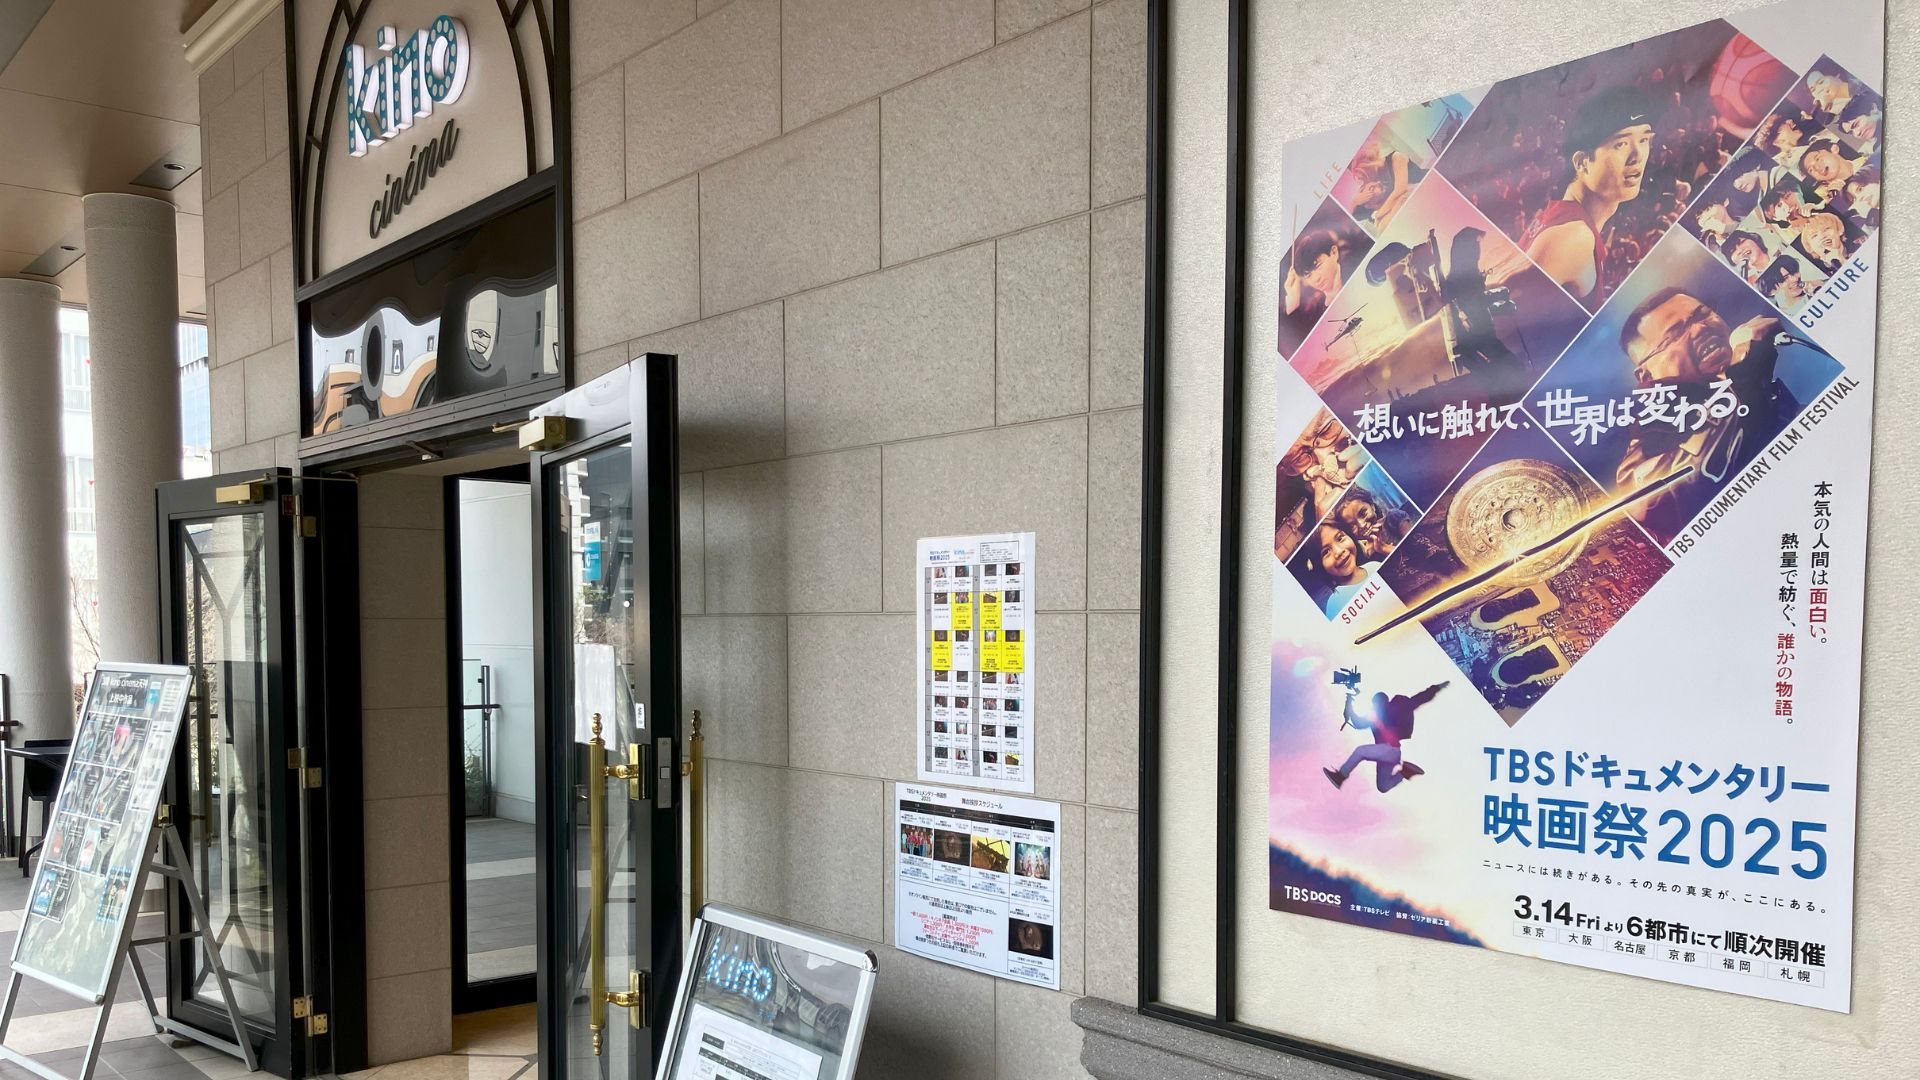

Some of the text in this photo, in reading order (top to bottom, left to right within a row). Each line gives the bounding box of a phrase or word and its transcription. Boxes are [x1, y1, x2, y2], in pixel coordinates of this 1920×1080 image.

[346, 14, 470, 158] kino
[369, 118, 460, 239] cinéma
[1313, 162, 1342, 199] LIFE
[1799, 257, 1870, 329] CULTURE
[1669, 375, 1860, 560] TBS DOCUMENTARY FILM FESTIVAL
[1809, 480, 1833, 644] 本気の人間は面白い。
[1341, 581, 1381, 624] SOCIAL
[1483, 747, 1830, 804] TBSドキュメンタリー
[1483, 792, 1828, 881] 映画祭2025
[1284, 885, 1342, 905] TBS DOCS
[1522, 925, 1545, 939] 東京
[1568, 932, 1592, 946] 大阪
[1613, 940, 1647, 955] 名古屋
[706, 936, 774, 1002] kino
[1668, 948, 1696, 963] 京都
[1723, 957, 1751, 973] 福岡
[1780, 967, 1811, 983] 札幌
